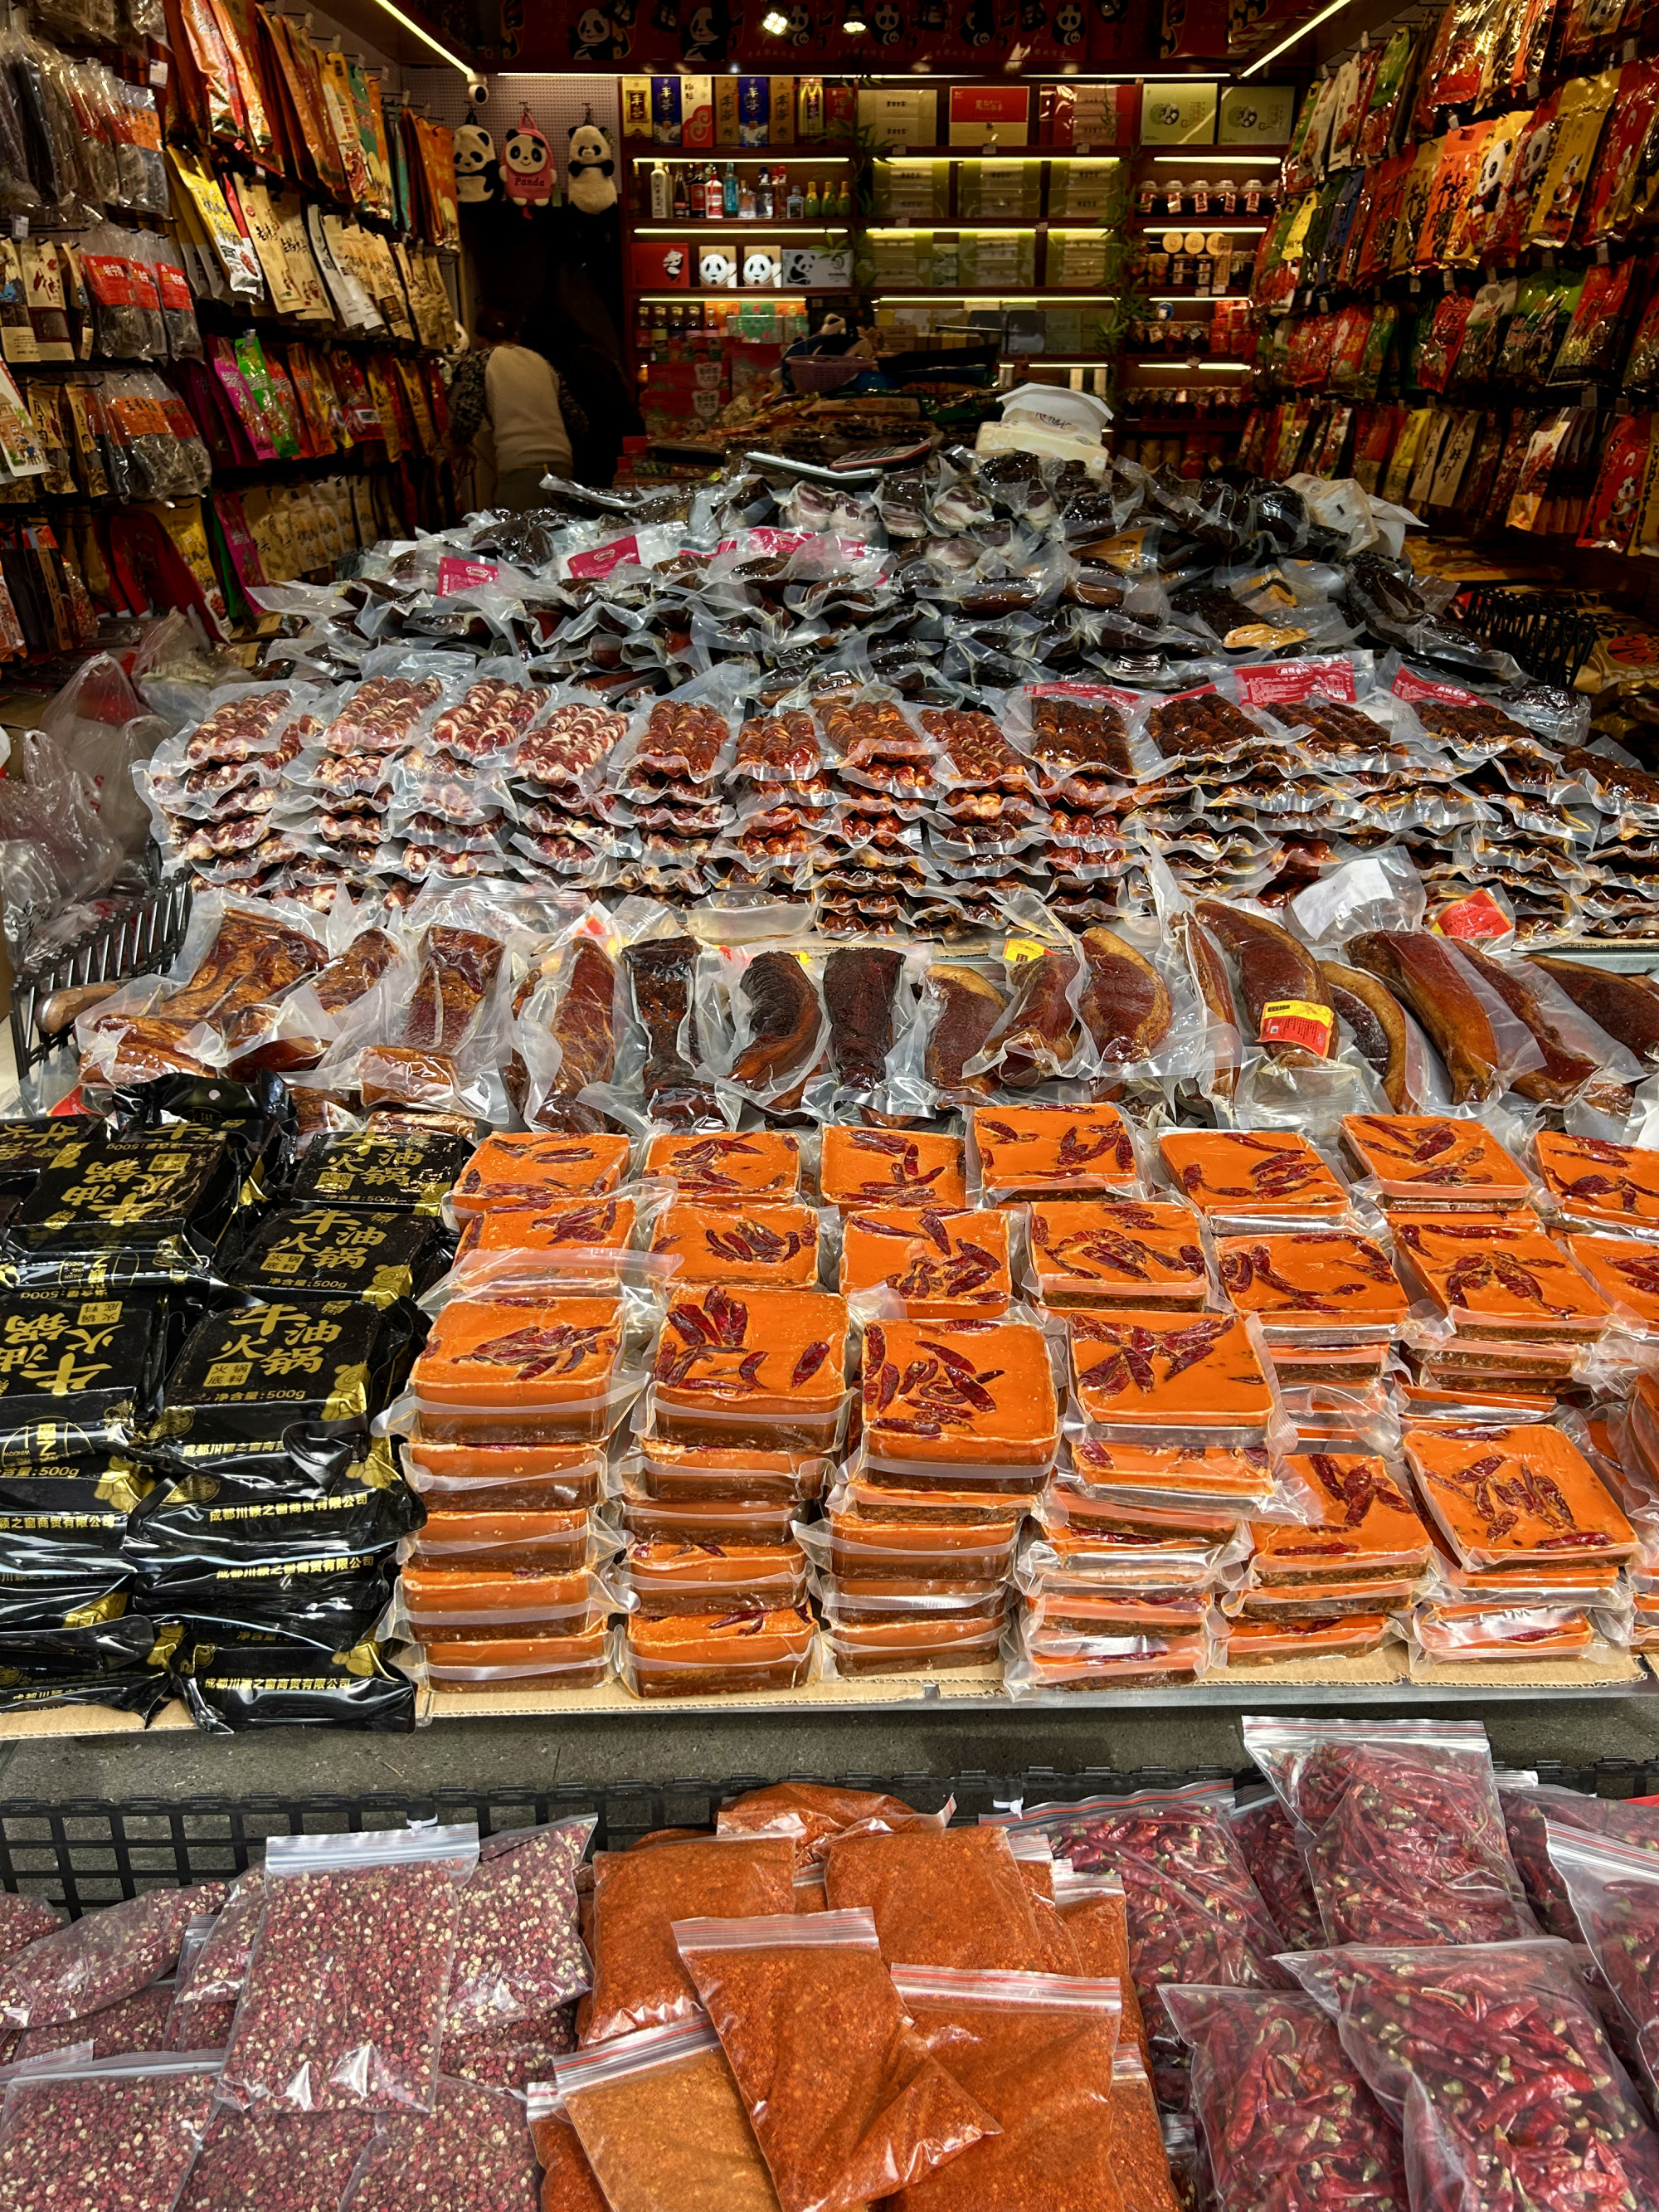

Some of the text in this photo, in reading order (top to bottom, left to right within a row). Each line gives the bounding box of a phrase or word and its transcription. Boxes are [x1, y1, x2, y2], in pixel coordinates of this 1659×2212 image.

[515, 177, 545, 187] Panda
[318, 1152, 411, 1186] 火锅
[289, 1210, 388, 1245] 牛油
[267, 1232, 368, 1269] 火锅
[270, 1254, 301, 1264] 火锅
[268, 1277, 348, 1289] 净含量:500g
[228, 1303, 343, 1346] 牛油
[5, 1313, 125, 1354] 火锅
[207, 1334, 324, 1376] 火锅
[213, 1364, 249, 1374] 火锅
[207, 1374, 245, 1384] 底料
[215, 1389, 306, 1401] 净含量:500g
[0, 1466, 80, 1478] 含量:500g
